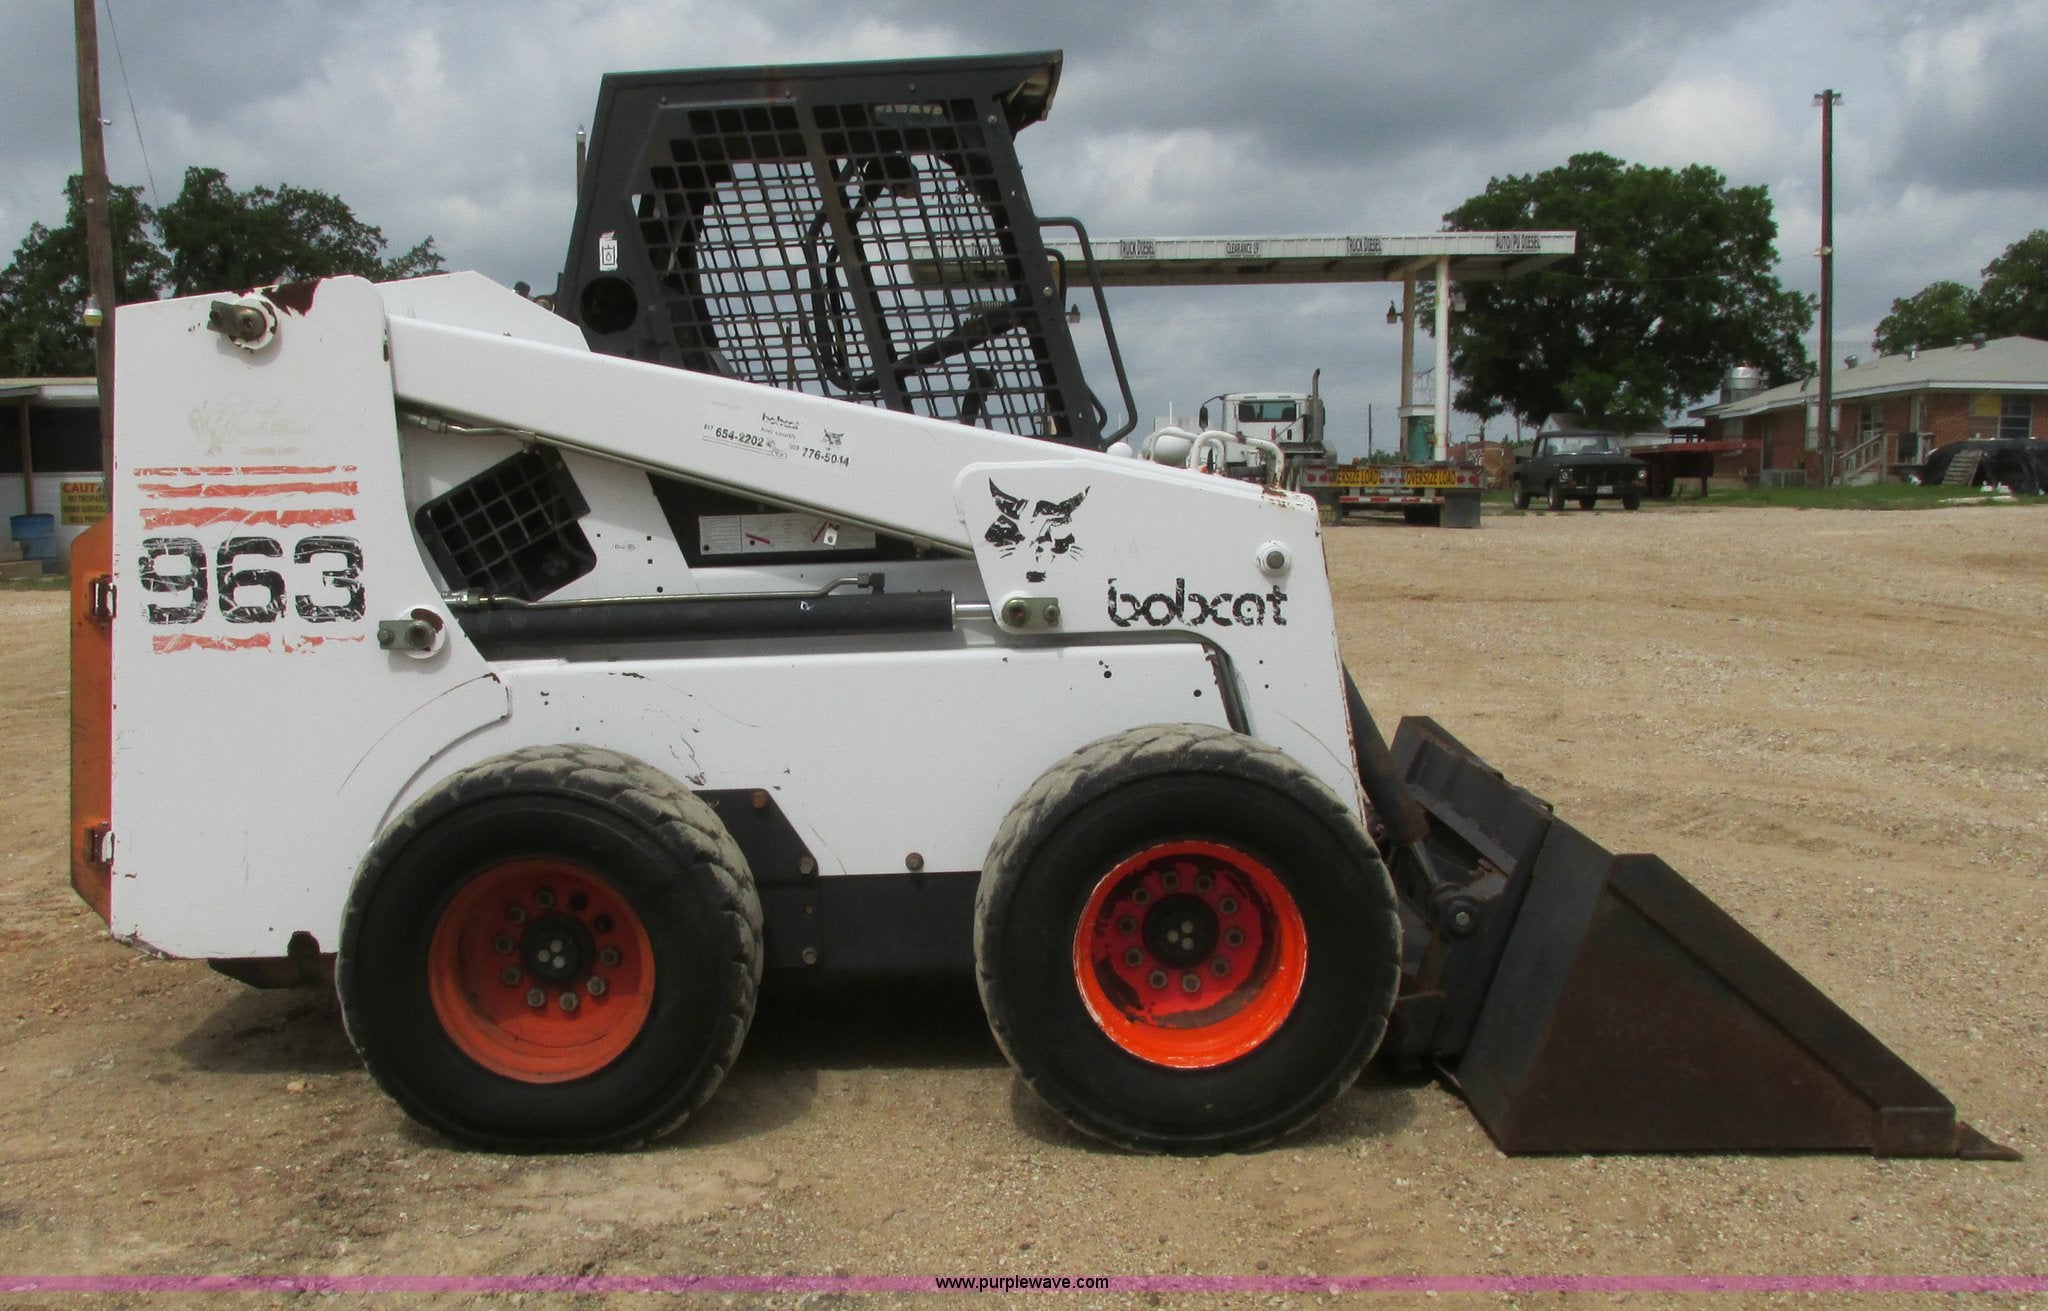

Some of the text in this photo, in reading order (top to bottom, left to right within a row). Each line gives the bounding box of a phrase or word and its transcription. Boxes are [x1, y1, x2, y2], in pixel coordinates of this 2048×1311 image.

[716, 427, 765, 448] 654-2202
[63, 483, 97, 493] CAUT
[138, 535, 366, 625] 963
[1107, 577, 1288, 628] bobcat
